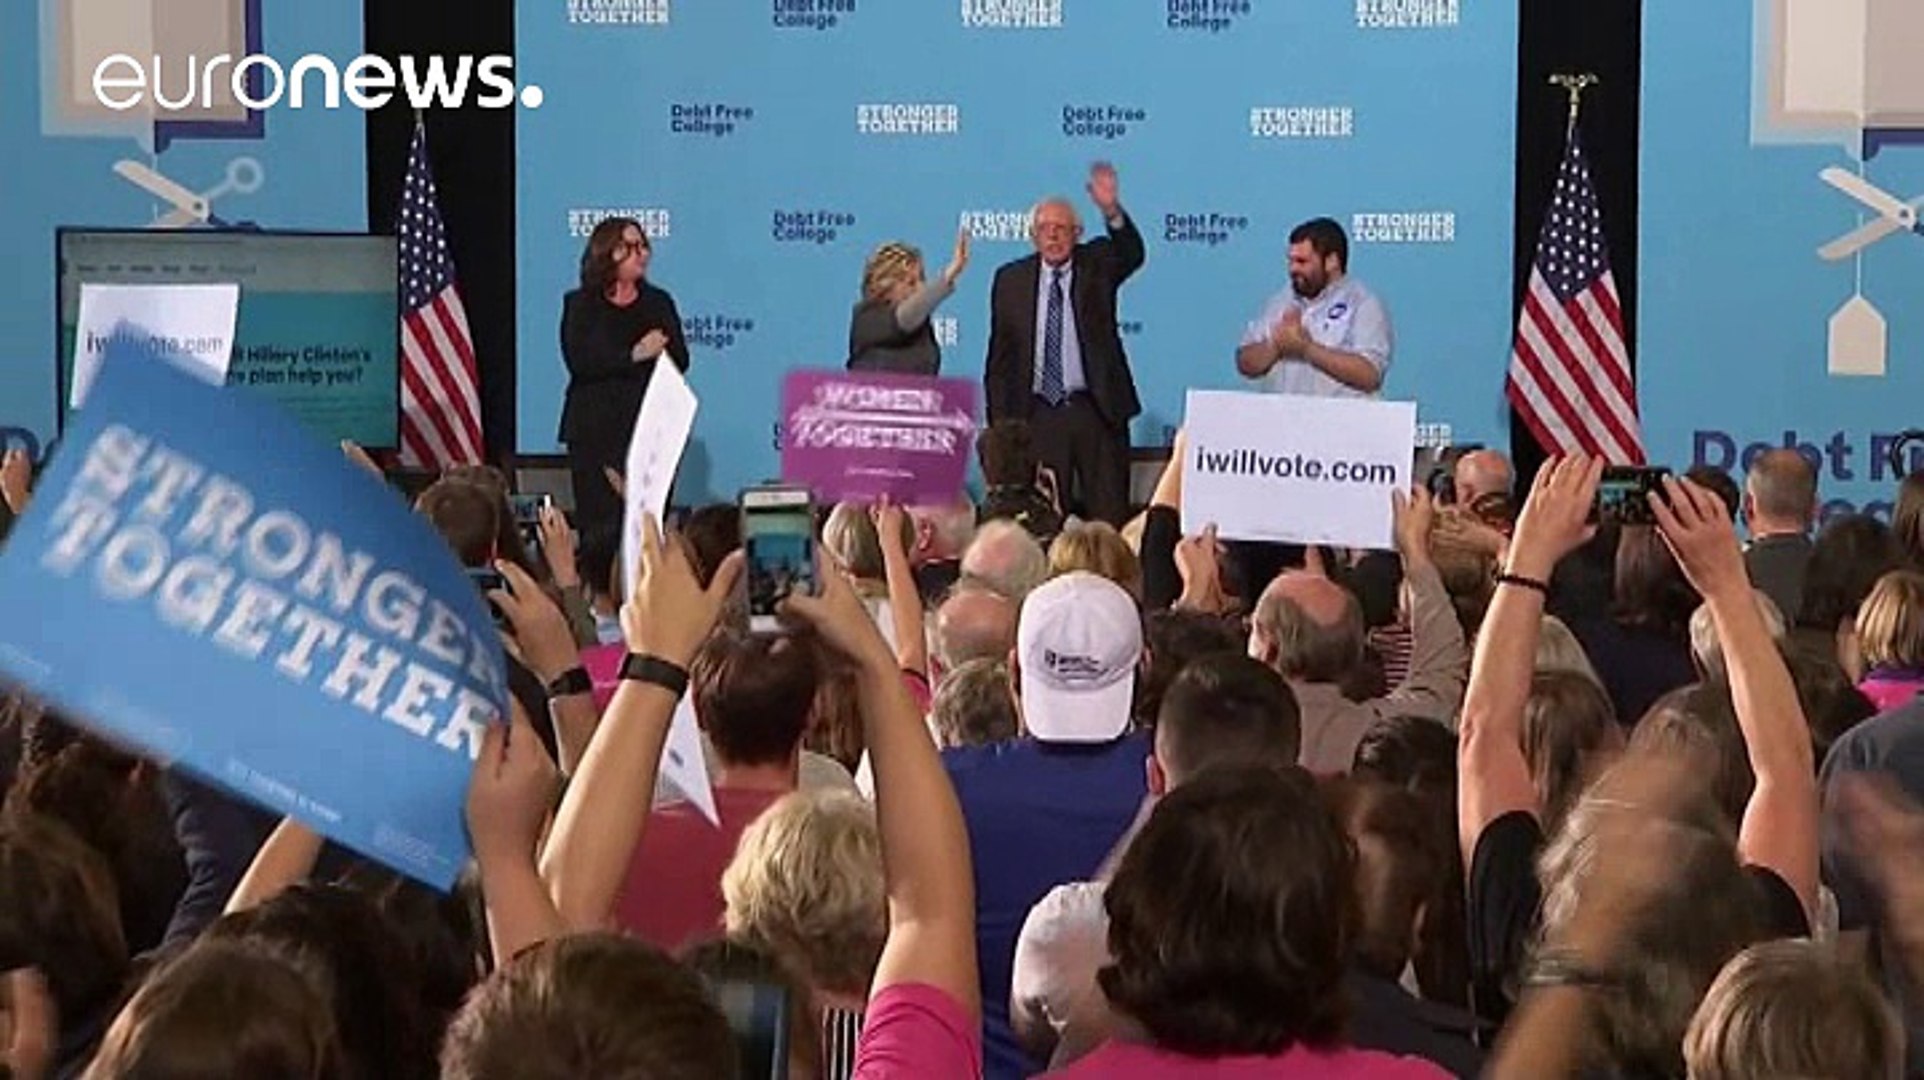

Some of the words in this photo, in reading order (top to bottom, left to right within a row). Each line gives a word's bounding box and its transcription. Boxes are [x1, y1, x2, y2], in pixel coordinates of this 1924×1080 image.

[1167, 0, 1208, 14] Debt
[1212, 0, 1251, 15] Free
[569, 11, 669, 23] TOGETHER
[773, 13, 837, 30] College
[961, 13, 1062, 27] TOGETHER
[1167, 13, 1231, 32] College
[1357, 12, 1460, 28] TOGETHER
[671, 103, 711, 118] Debt
[715, 104, 754, 120] Free
[857, 104, 958, 119] STRONGER
[1062, 105, 1104, 120] Debt
[1108, 106, 1146, 122] Free
[1251, 107, 1353, 122] STRONGER
[671, 119, 735, 137] College
[858, 118, 958, 133] TOGETHER
[1062, 121, 1126, 139] College
[1252, 121, 1353, 137] TOGETHER
[773, 211, 813, 227] Debt
[817, 211, 856, 227] Free
[1165, 213, 1206, 228] Debt
[1209, 213, 1248, 229] Free
[1353, 212, 1456, 227] STRONGER
[772, 226, 837, 244] College
[1164, 227, 1228, 245] College
[1354, 226, 1456, 241] TOGETHER
[684, 316, 712, 331] ebt
[716, 316, 754, 332] Free
[684, 331, 735, 349] ollege
[303, 345, 371, 362] Clinton's
[249, 367, 284, 385] plan
[287, 366, 323, 386] help
[325, 365, 363, 386] you?
[814, 381, 944, 414] WOMEN
[790, 420, 957, 455] TOGETHER
[1196, 445, 1397, 485] iwillvote.com
[76, 423, 503, 700] STRONGER
[42, 489, 501, 760] TOGETHER
